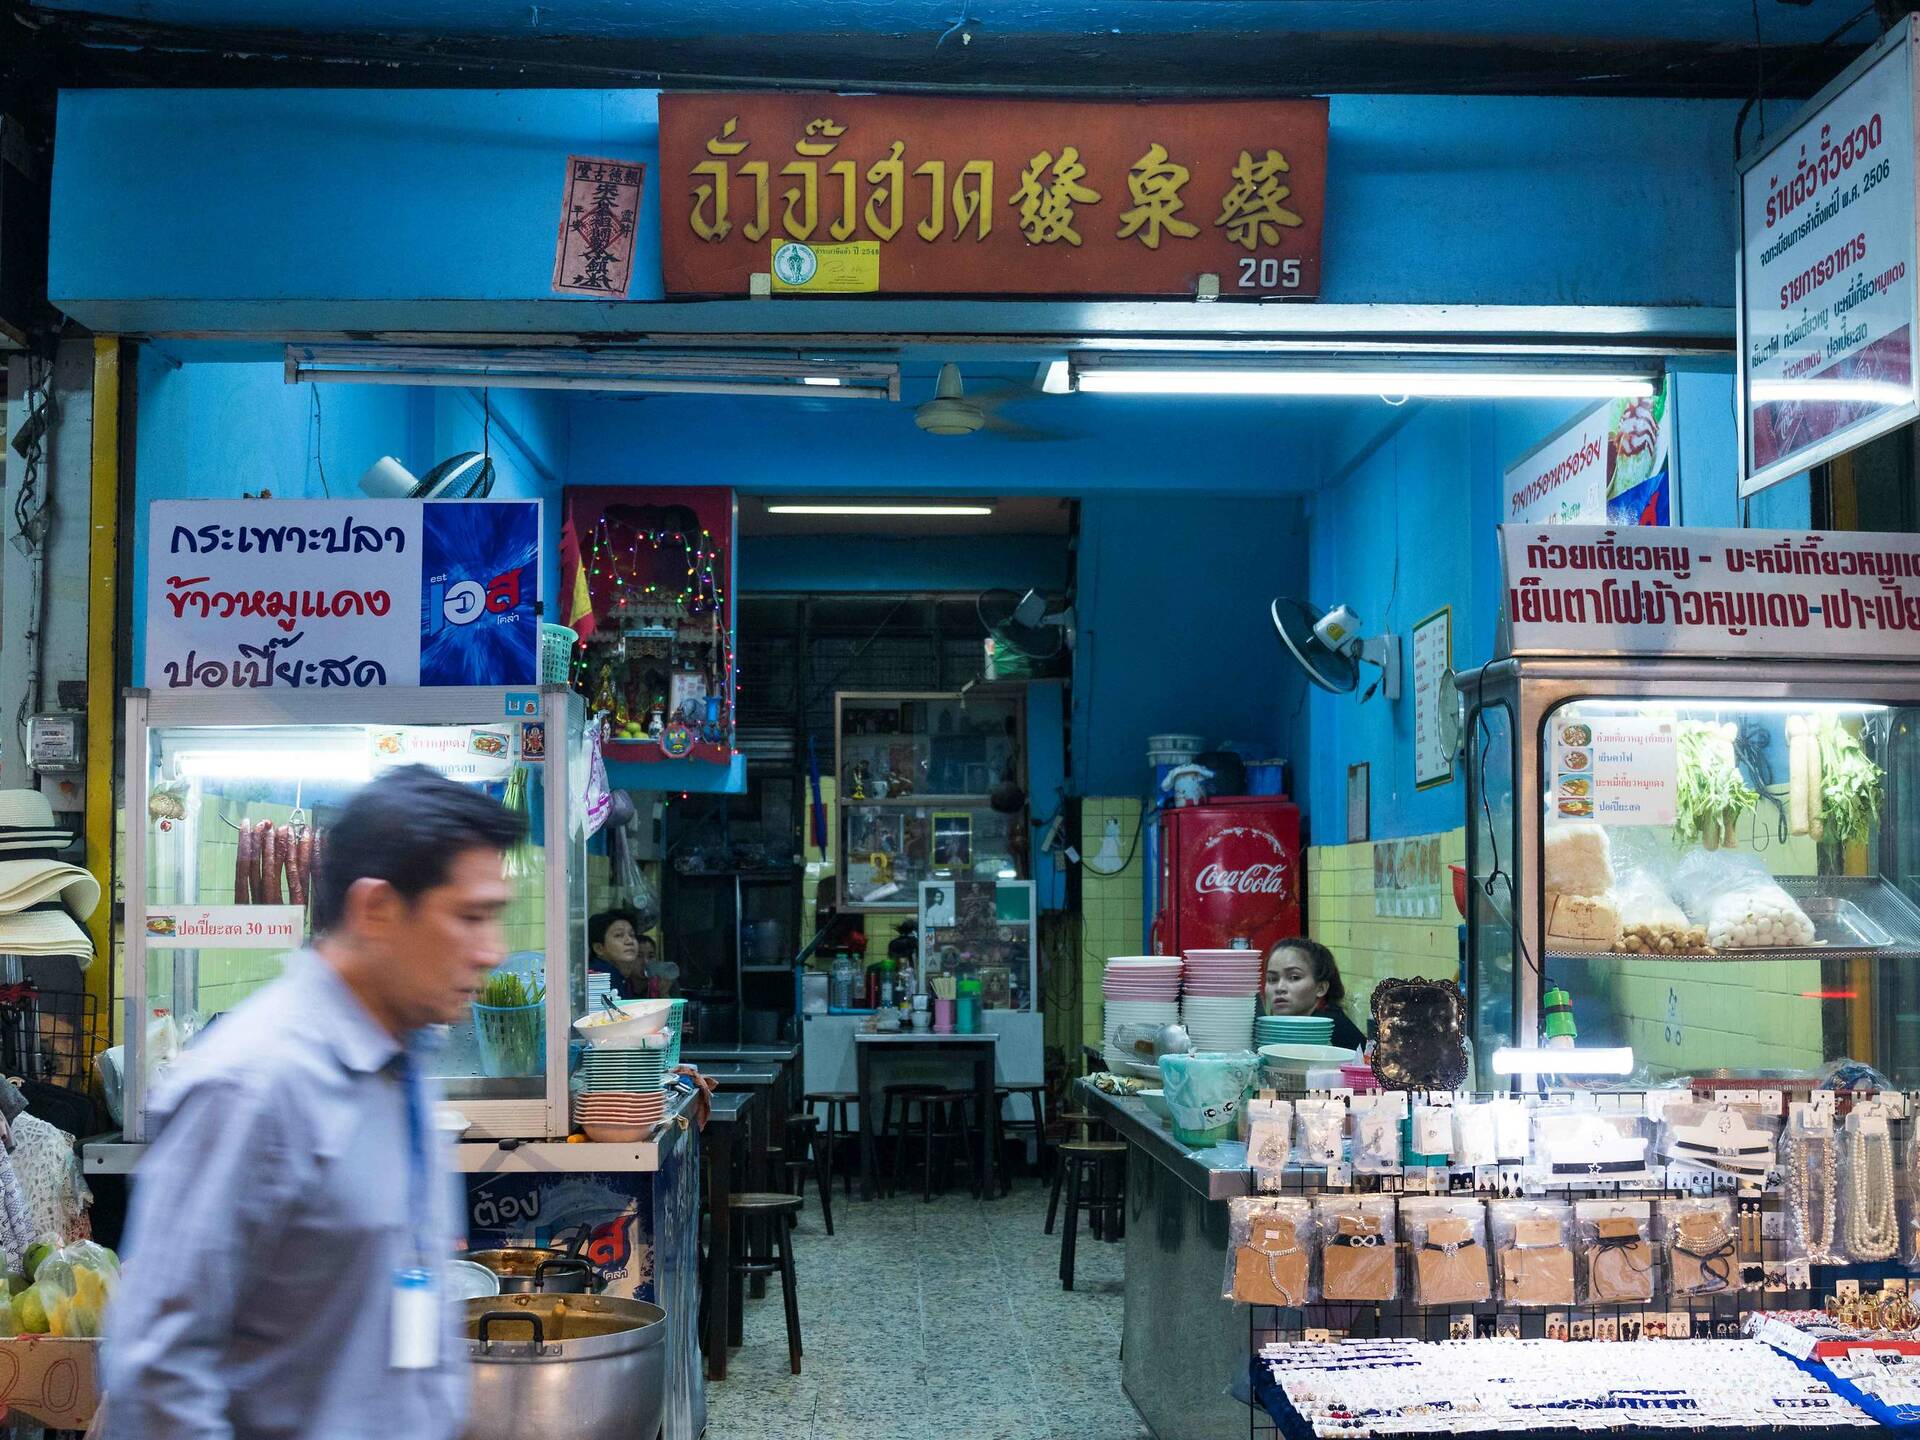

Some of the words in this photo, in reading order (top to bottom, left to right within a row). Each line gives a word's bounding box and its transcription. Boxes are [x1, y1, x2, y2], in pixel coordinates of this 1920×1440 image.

[1842, 183, 1860, 210] พ.ศ.
[1863, 159, 1890, 193] 2506
[1238, 258, 1302, 289] 205
[1780, 232, 1867, 311] รายการอาหาร
[170, 516, 405, 554] กระเพาะปลา
[430, 573, 448, 582] est
[166, 576, 391, 632] ข้าวหมูแดง
[163, 631, 387, 688] ปอเปี๊ยะสด
[177, 912, 242, 936] ปอเปี๊ยะสด
[245, 922, 263, 936] 30
[267, 923, 292, 936] บาท
[473, 1188, 540, 1227] ต้อง
